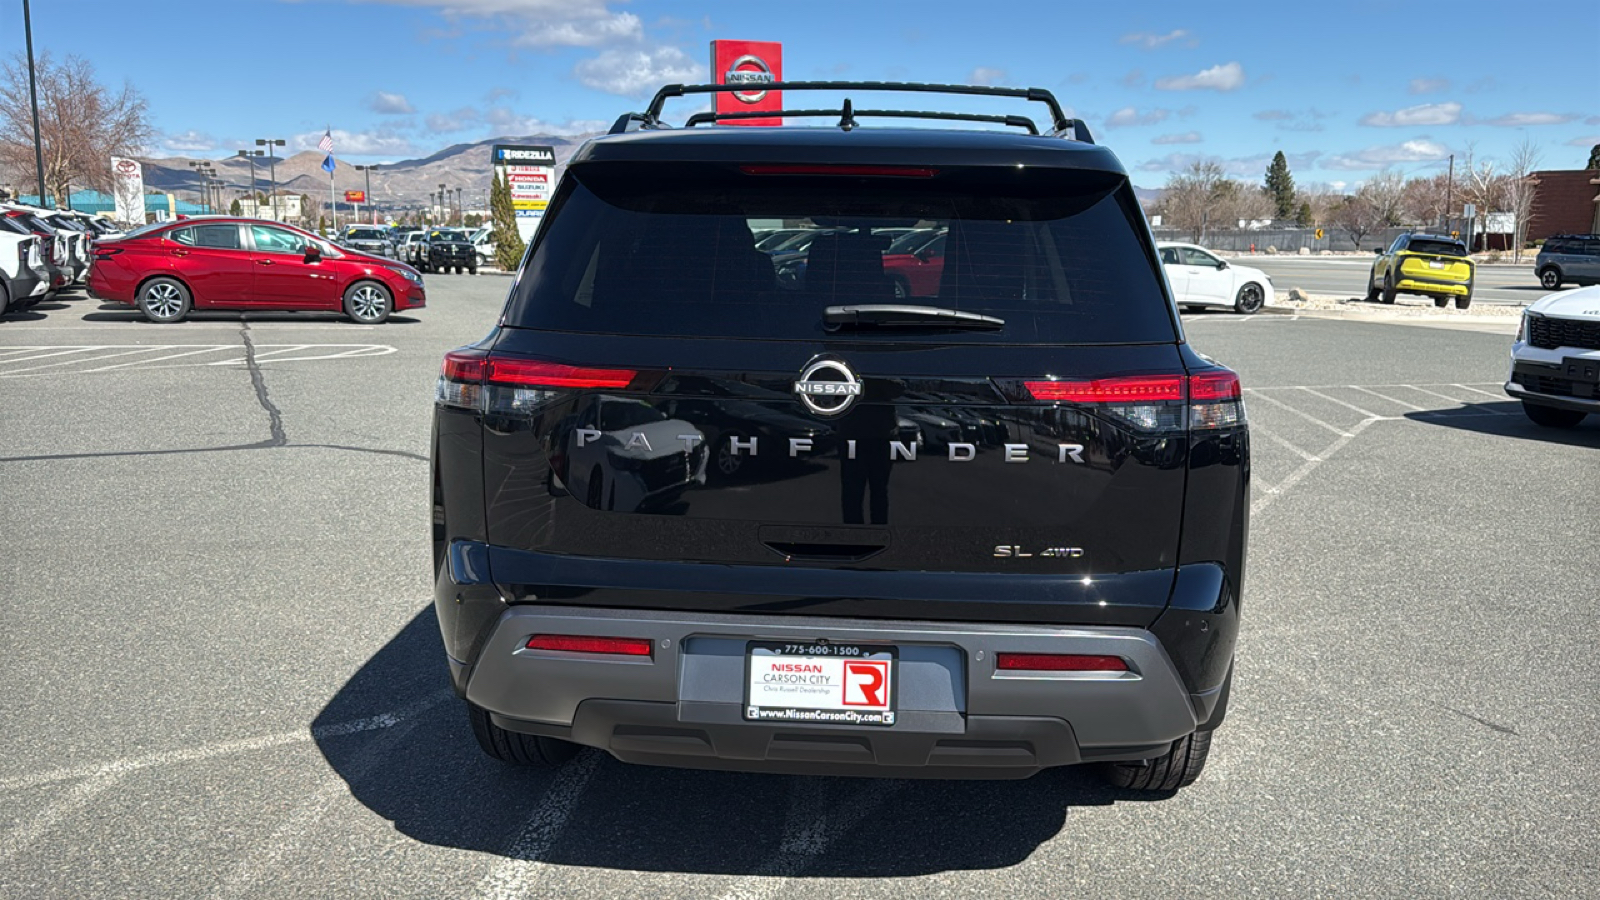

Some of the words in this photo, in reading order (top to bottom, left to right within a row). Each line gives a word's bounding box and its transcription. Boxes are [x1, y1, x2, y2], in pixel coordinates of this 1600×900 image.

[730, 74, 771, 82] NISSAN
[510, 150, 552, 160] RIDEZILLA
[795, 383, 860, 395] NISSAN
[576, 428, 1085, 464] PATHFINDER
[993, 545, 1033, 557] SL
[1040, 547, 1085, 557] 4WD
[785, 644, 860, 656] 775-600-1500
[771, 663, 823, 673] NISSAN
[763, 673, 806, 684] CARSON
[809, 675, 831, 685] CITY
[763, 684, 778, 692] Chris
[780, 685, 798, 693] Russell
[800, 686, 831, 695] Dealership
[760, 708, 882, 724] www.NissanCarsonCity.com
